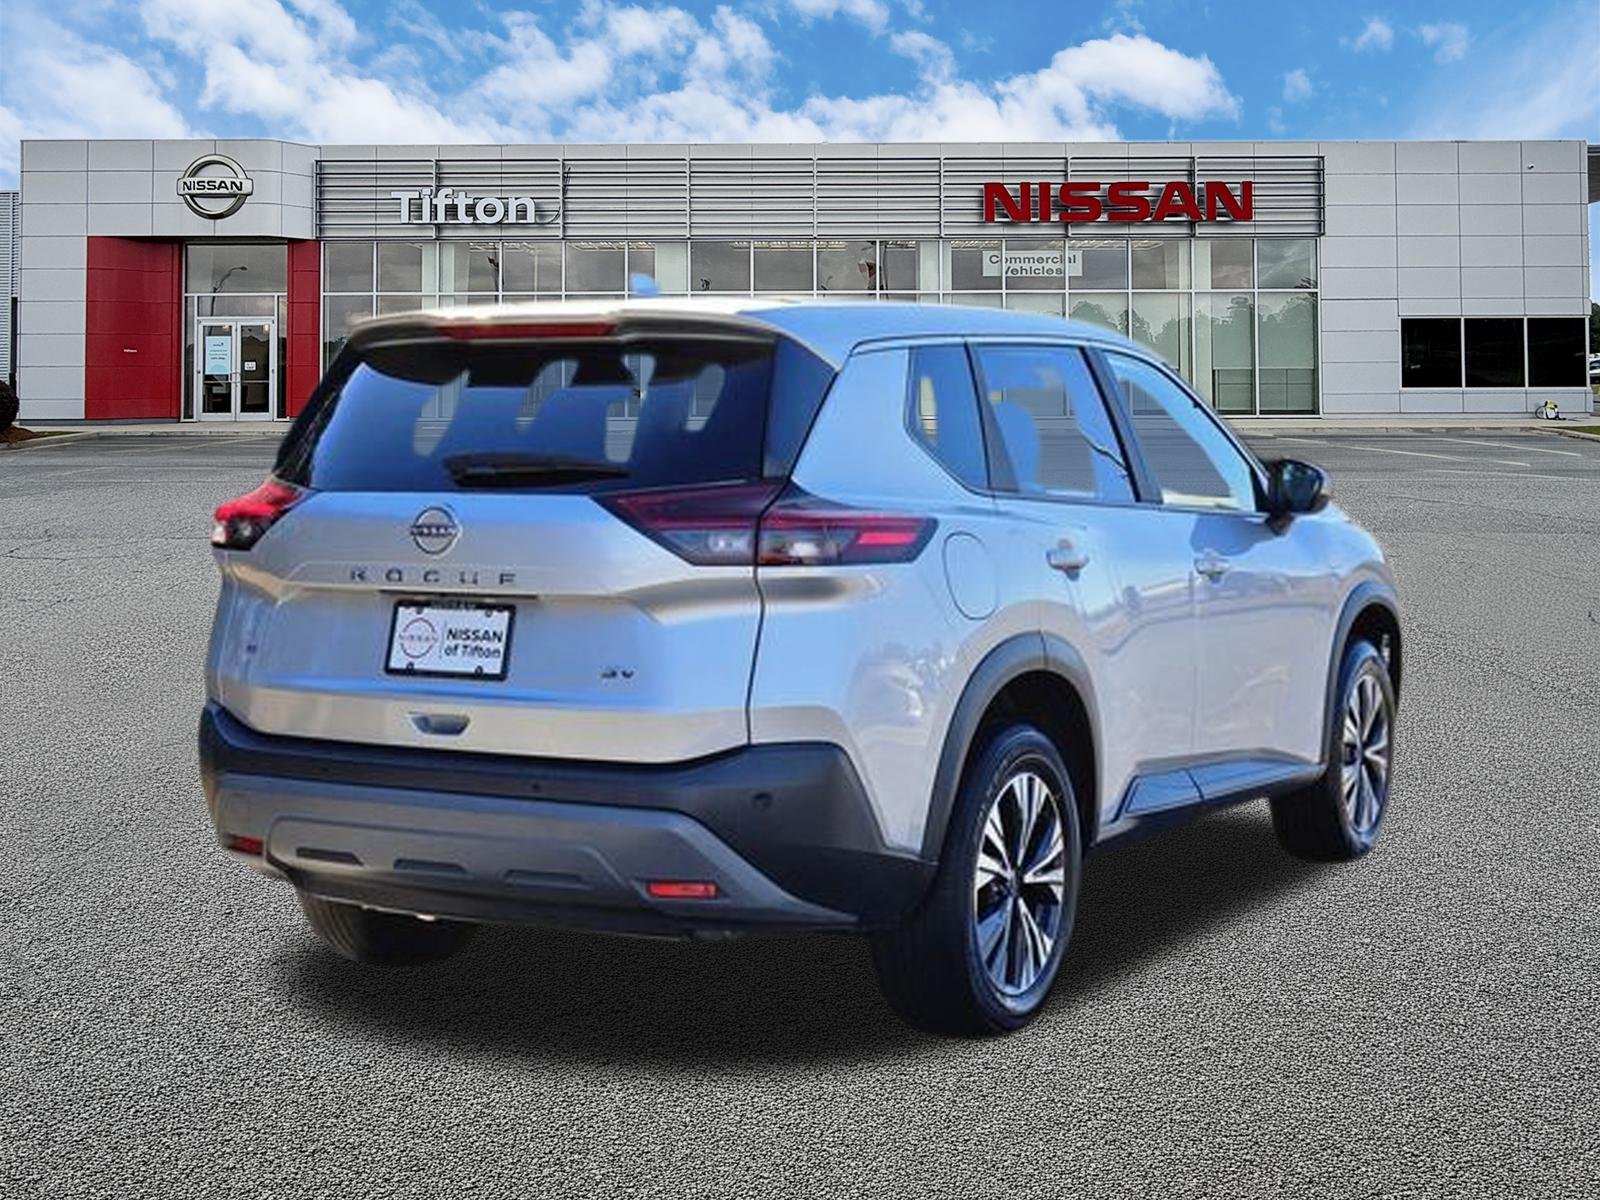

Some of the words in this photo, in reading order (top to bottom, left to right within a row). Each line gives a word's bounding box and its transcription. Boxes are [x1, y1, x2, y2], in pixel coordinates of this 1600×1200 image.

[183, 180, 243, 191] NISSAN
[391, 188, 536, 224] Tifton
[984, 181, 1254, 222] NISSAN
[350, 565, 517, 585] ROGUE
[446, 628, 503, 643] NISSAN
[444, 643, 459, 656] of
[462, 645, 501, 659] Tifton
